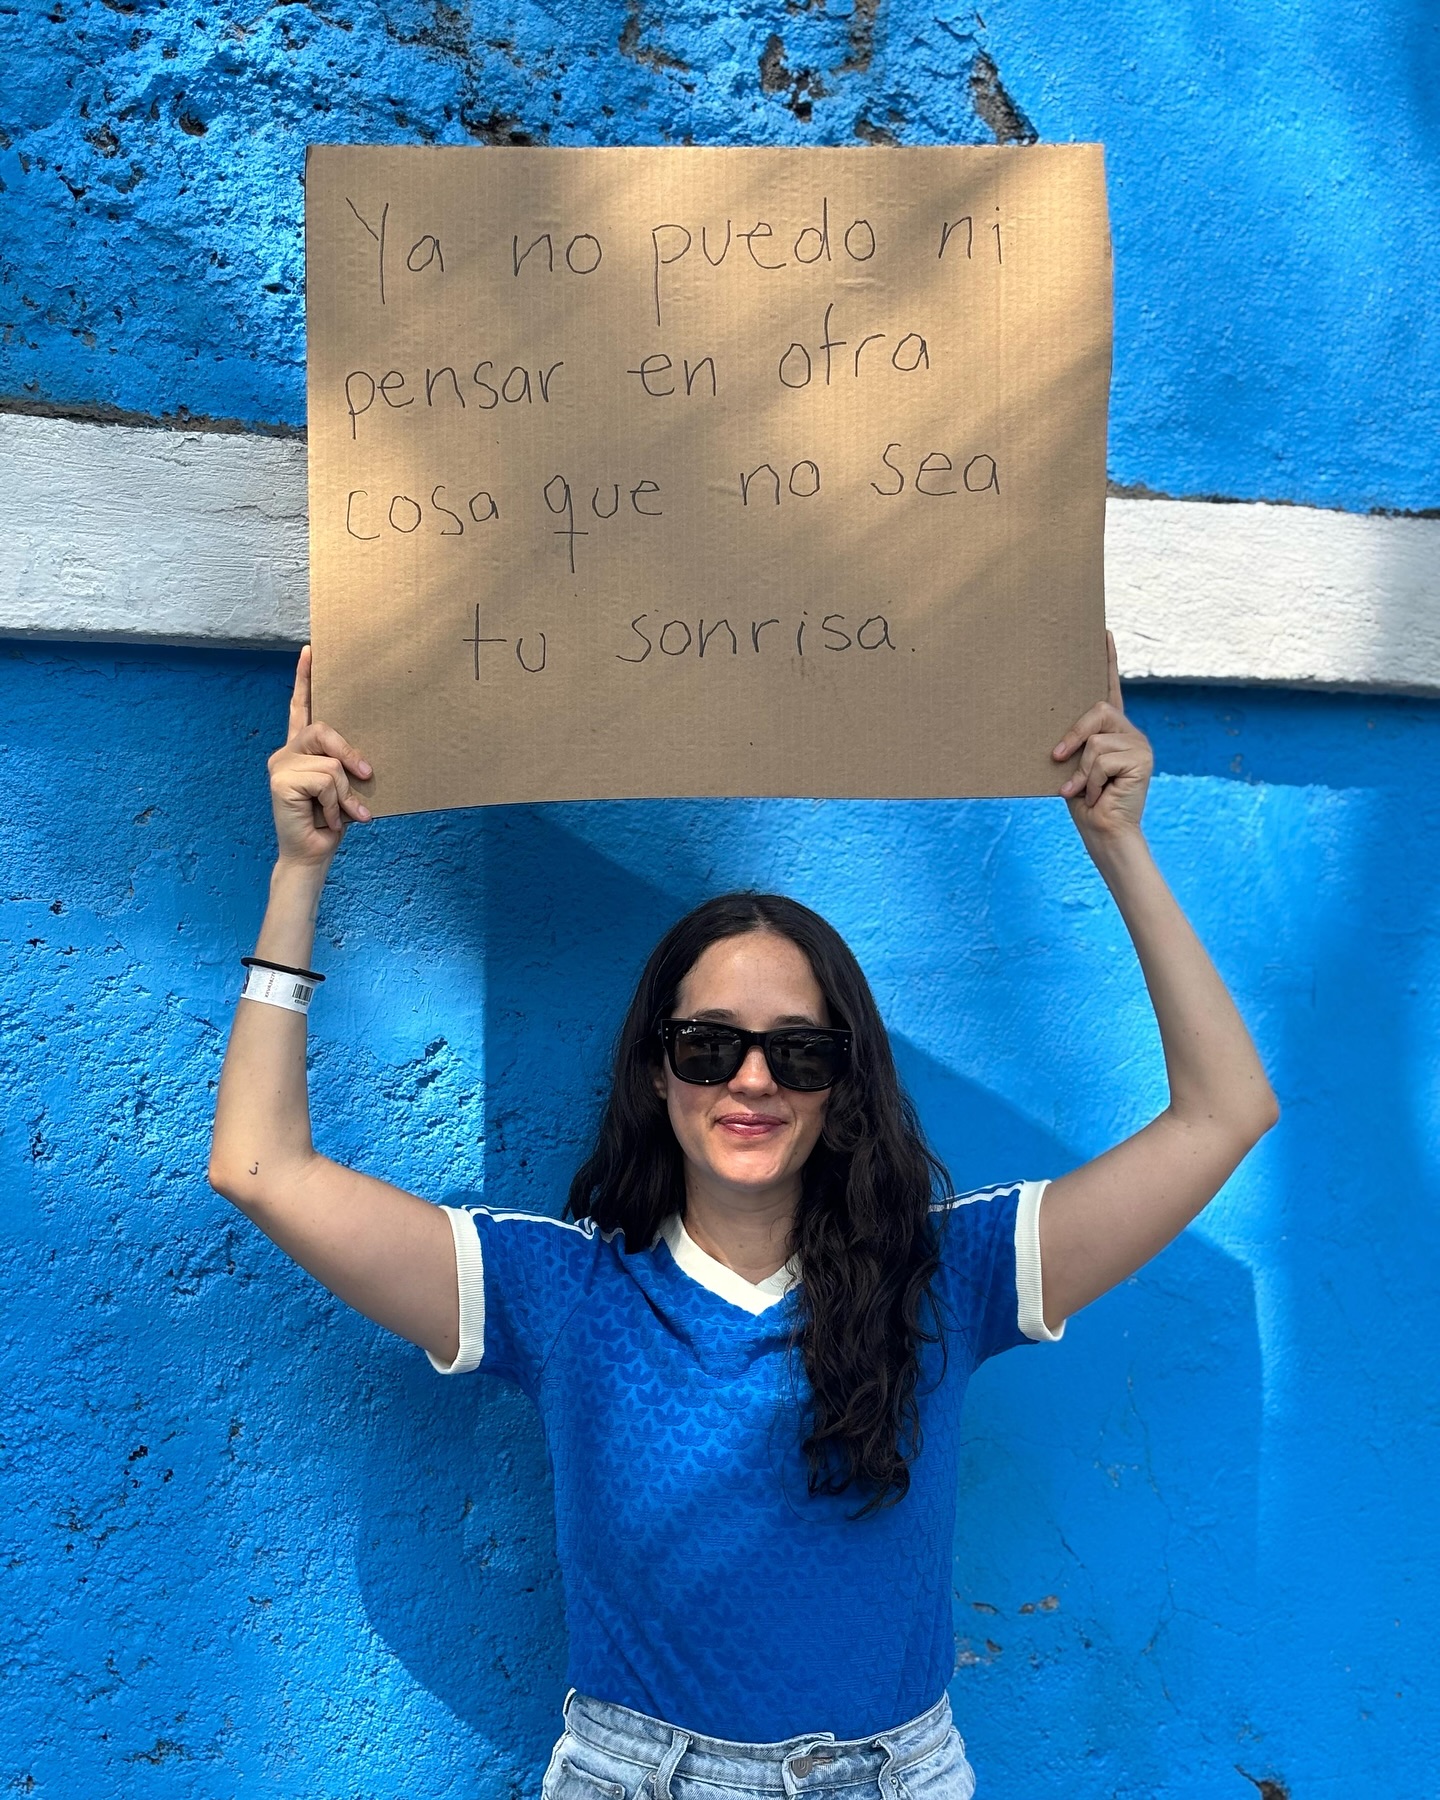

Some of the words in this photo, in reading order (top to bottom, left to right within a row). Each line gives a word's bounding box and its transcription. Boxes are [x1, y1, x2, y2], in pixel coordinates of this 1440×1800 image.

[345, 196, 445, 305] Ya
[512, 233, 603, 277] no
[651, 196, 876, 327] puedo
[937, 205, 1003, 265] ni
[343, 360, 565, 441] pensar
[626, 353, 717, 397] en
[778, 302, 930, 389] otra
[346, 485, 500, 541] cosa
[543, 474, 664, 574] que
[739, 459, 821, 507] no
[870, 443, 1001, 497] sea
[462, 602, 548, 681] tu
[615, 610, 917, 664] sonrisa.
